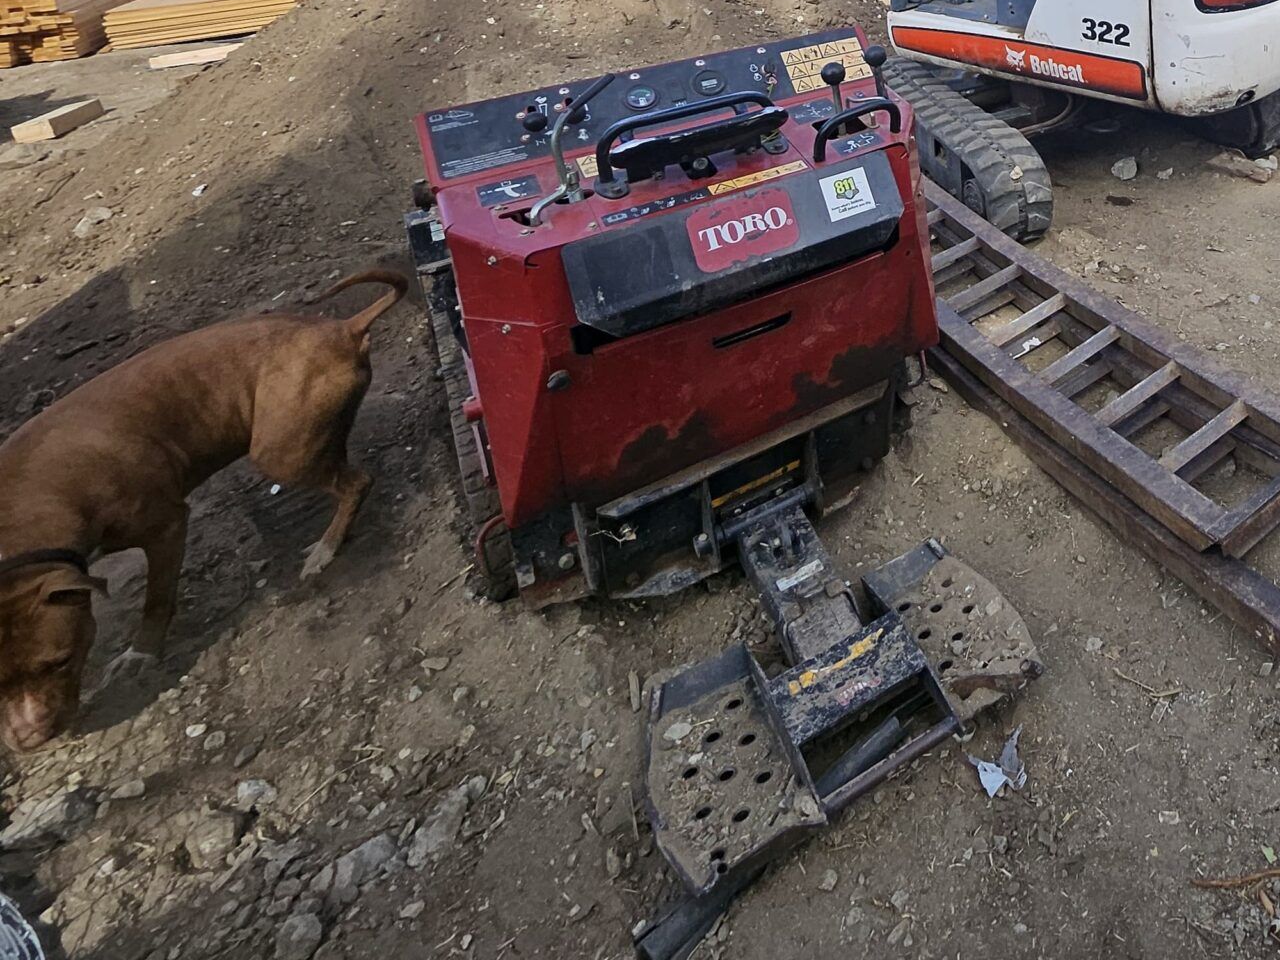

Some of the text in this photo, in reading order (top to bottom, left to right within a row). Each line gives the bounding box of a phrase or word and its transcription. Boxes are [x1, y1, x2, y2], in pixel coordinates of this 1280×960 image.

[1081, 17, 1131, 47] 322
[1029, 54, 1085, 83] Bobcat
[833, 176, 856, 194] 811
[698, 207, 787, 252] TORO
